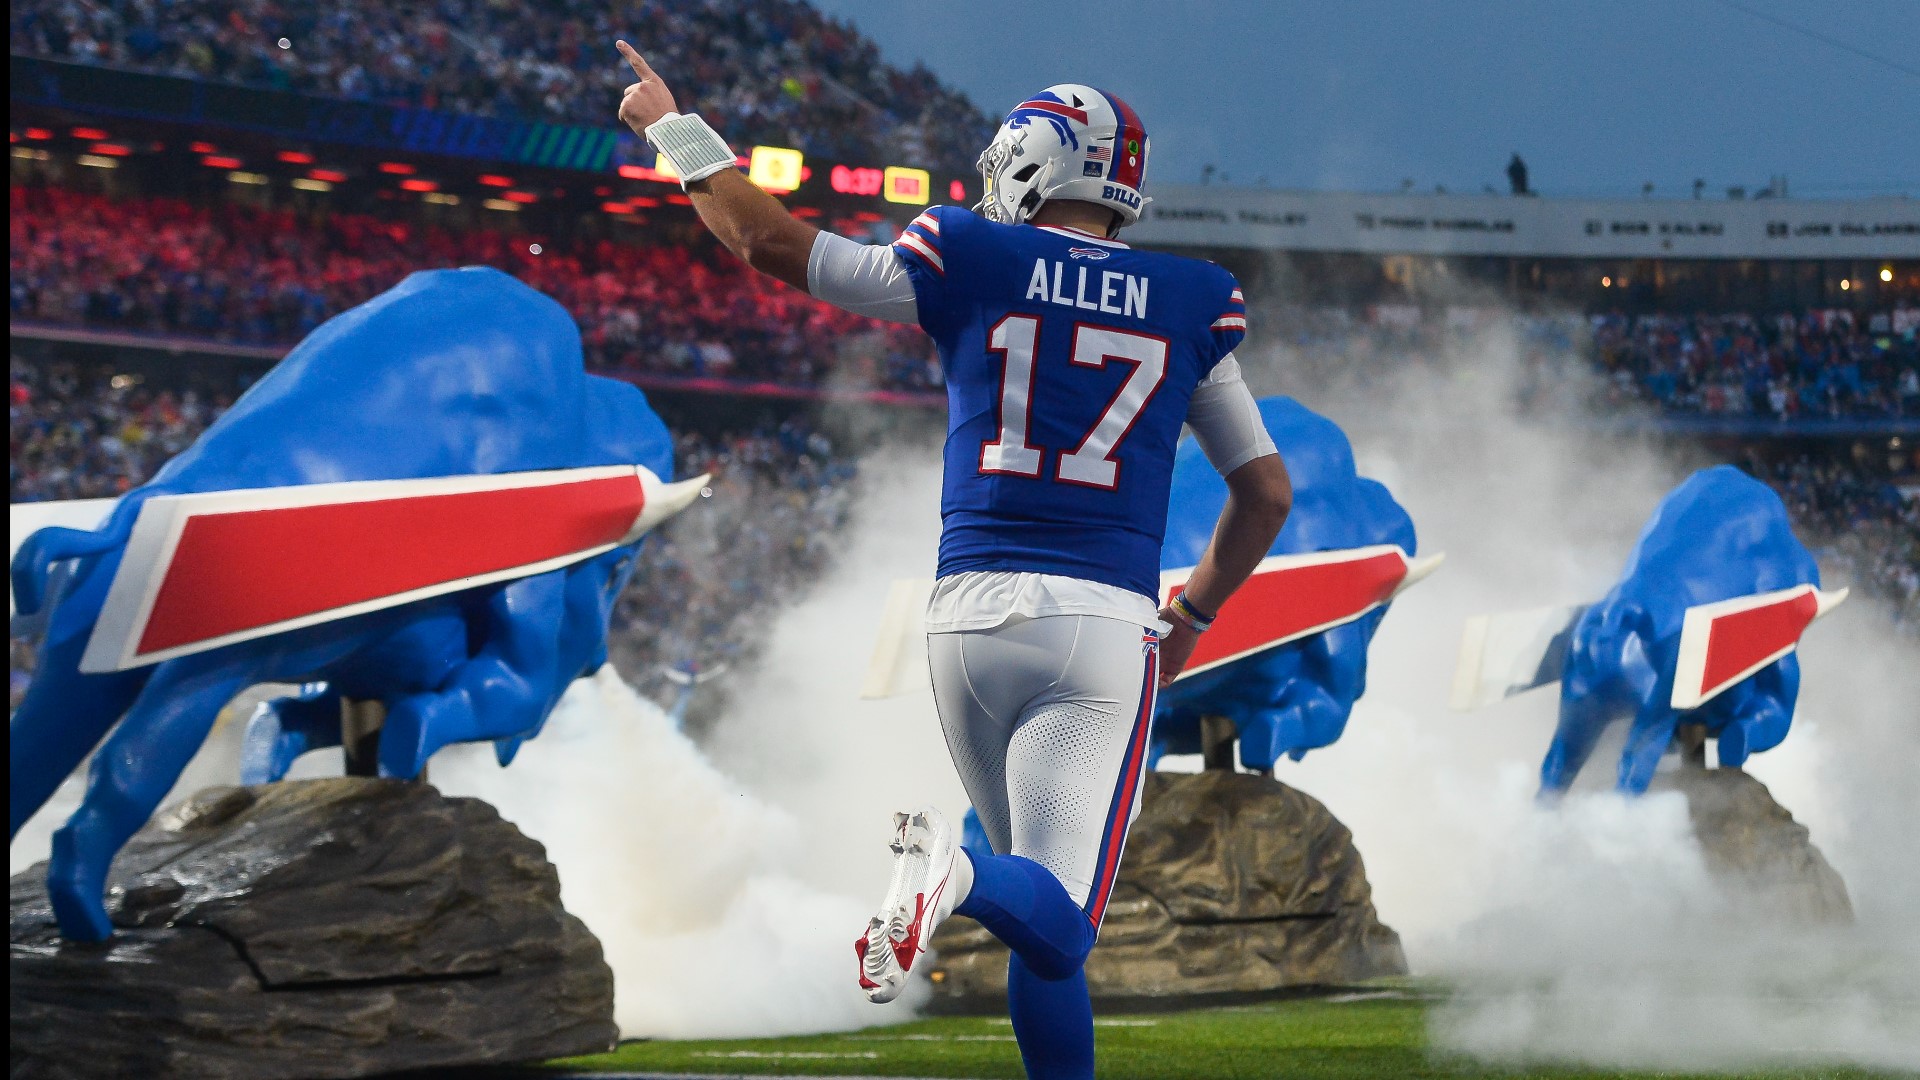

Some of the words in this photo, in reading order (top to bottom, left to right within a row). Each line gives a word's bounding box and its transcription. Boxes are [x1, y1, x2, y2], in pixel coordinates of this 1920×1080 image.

[1102, 185, 1142, 210] BILLS
[1026, 258, 1149, 319] ALLEN
[977, 312, 1171, 492] 17
